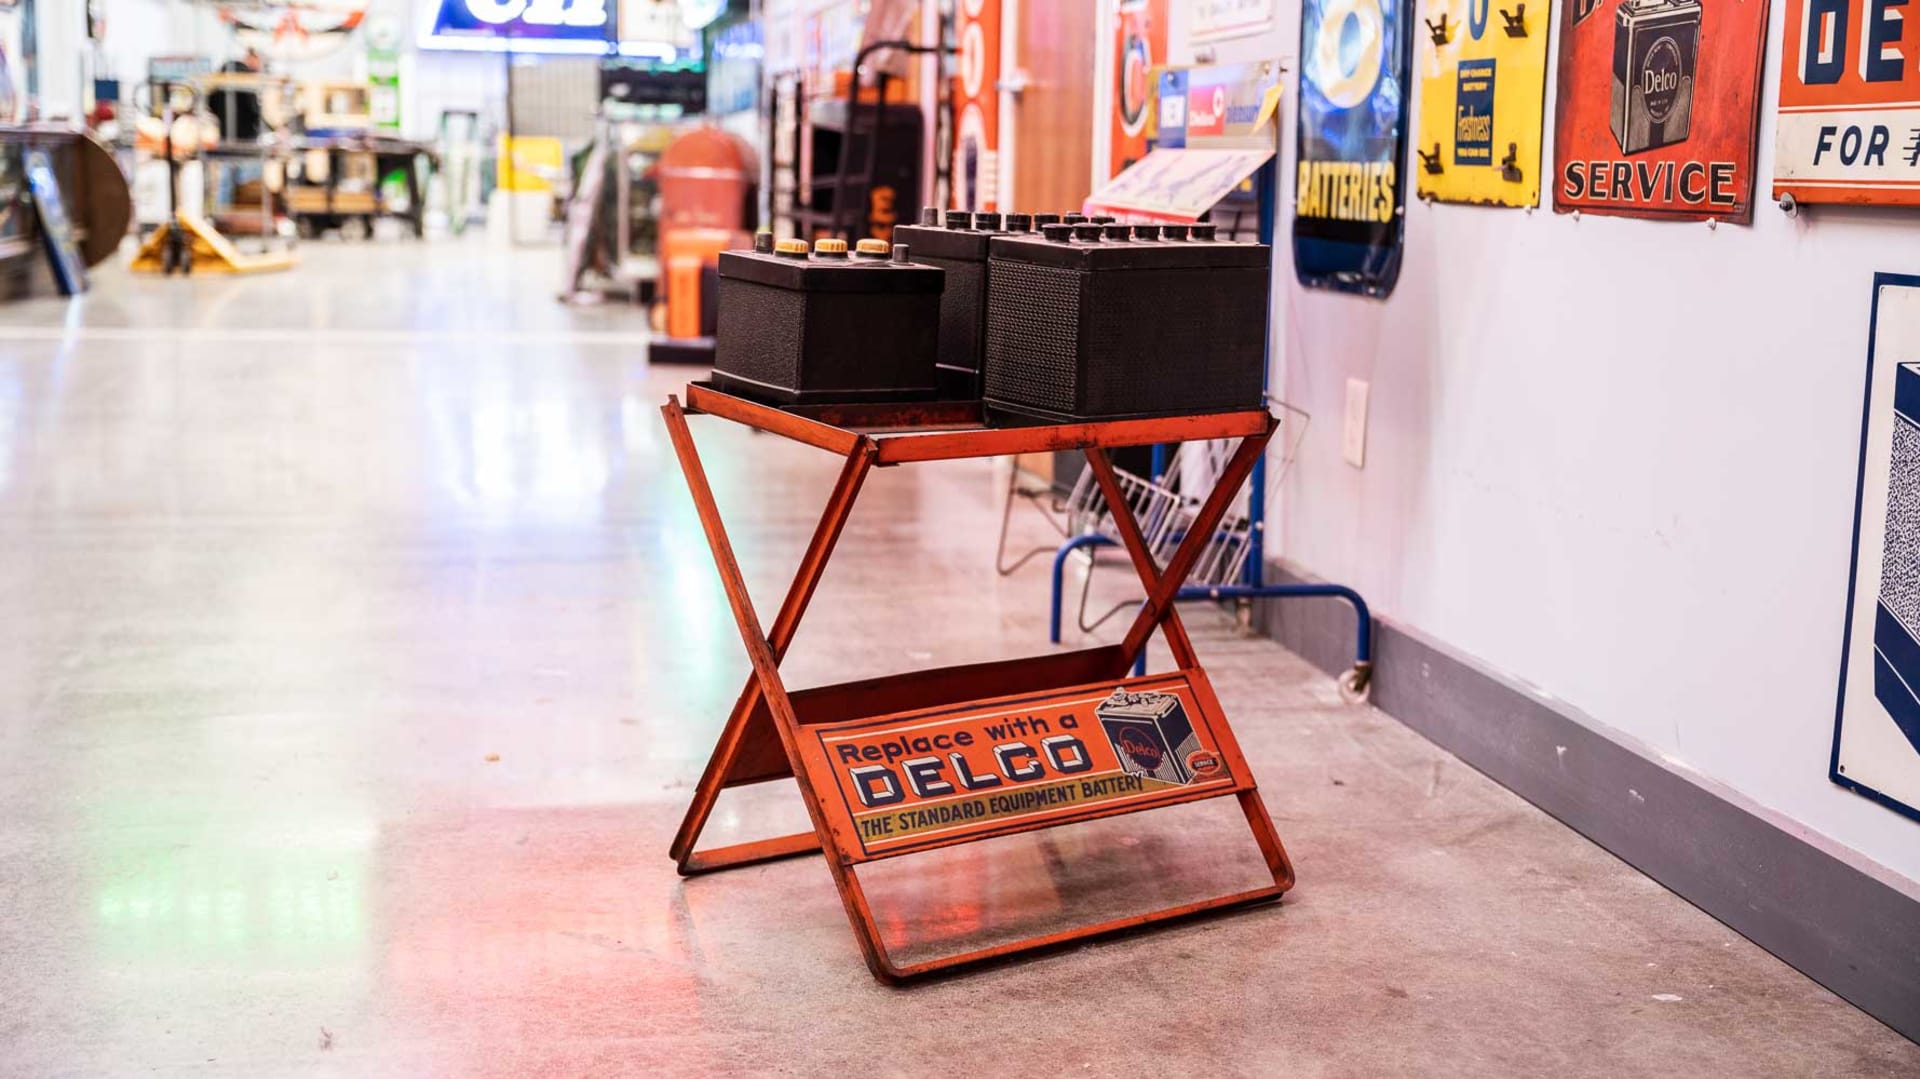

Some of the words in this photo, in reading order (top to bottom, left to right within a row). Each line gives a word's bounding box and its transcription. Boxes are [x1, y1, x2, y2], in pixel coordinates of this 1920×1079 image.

[1798, 0, 1920, 85] DE
[1644, 67, 1678, 95] Delco
[1813, 125, 1889, 166] FOR
[1297, 160, 1396, 223] BATTERIES
[1564, 160, 1737, 206] SERVICE
[836, 730, 975, 764] Replace
[984, 715, 1050, 741] with
[1059, 713, 1079, 730] a
[1122, 739, 1160, 757] Delco
[848, 734, 1094, 808] DELCO
[861, 815, 894, 838] THE
[899, 800, 986, 831] STANDARD
[989, 783, 1078, 815] EQUIPMENT
[1081, 773, 1144, 799] BATTERY
